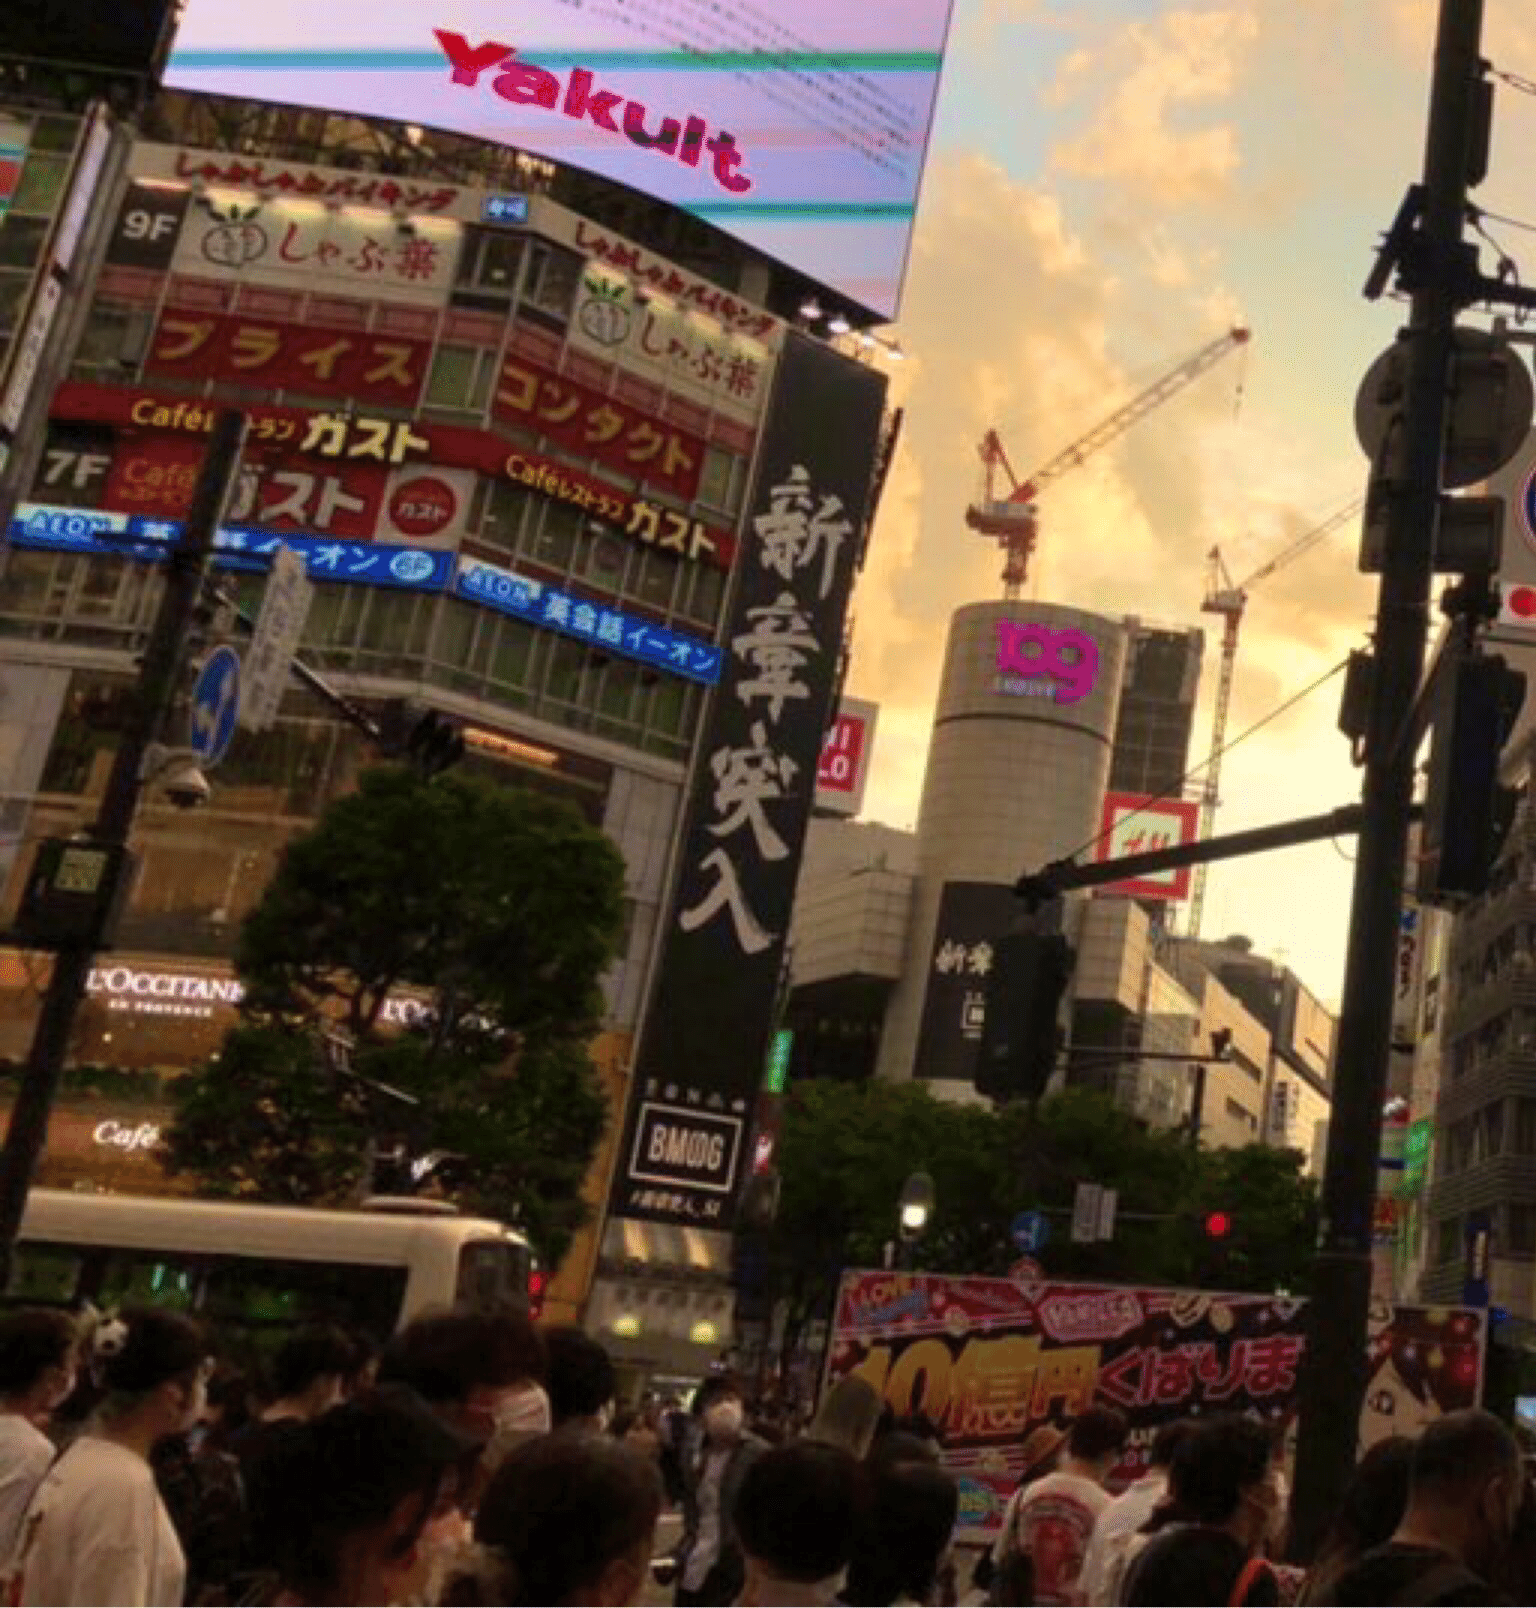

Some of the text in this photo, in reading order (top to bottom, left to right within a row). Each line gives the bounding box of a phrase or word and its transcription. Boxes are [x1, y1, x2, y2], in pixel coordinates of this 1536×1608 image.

[434, 28, 751, 192] Yakult
[123, 210, 177, 241] 9F
[279, 222, 436, 280] しゃぶ葉
[159, 320, 414, 386] プライス
[640, 311, 758, 398] しゃぶ葉
[302, 413, 429, 462] ガスト
[499, 363, 692, 475] コンタクト
[44, 449, 111, 487] 7F
[625, 500, 716, 560] ガスト
[996, 616, 1098, 705] 109
[680, 464, 852, 954] 新章突入
